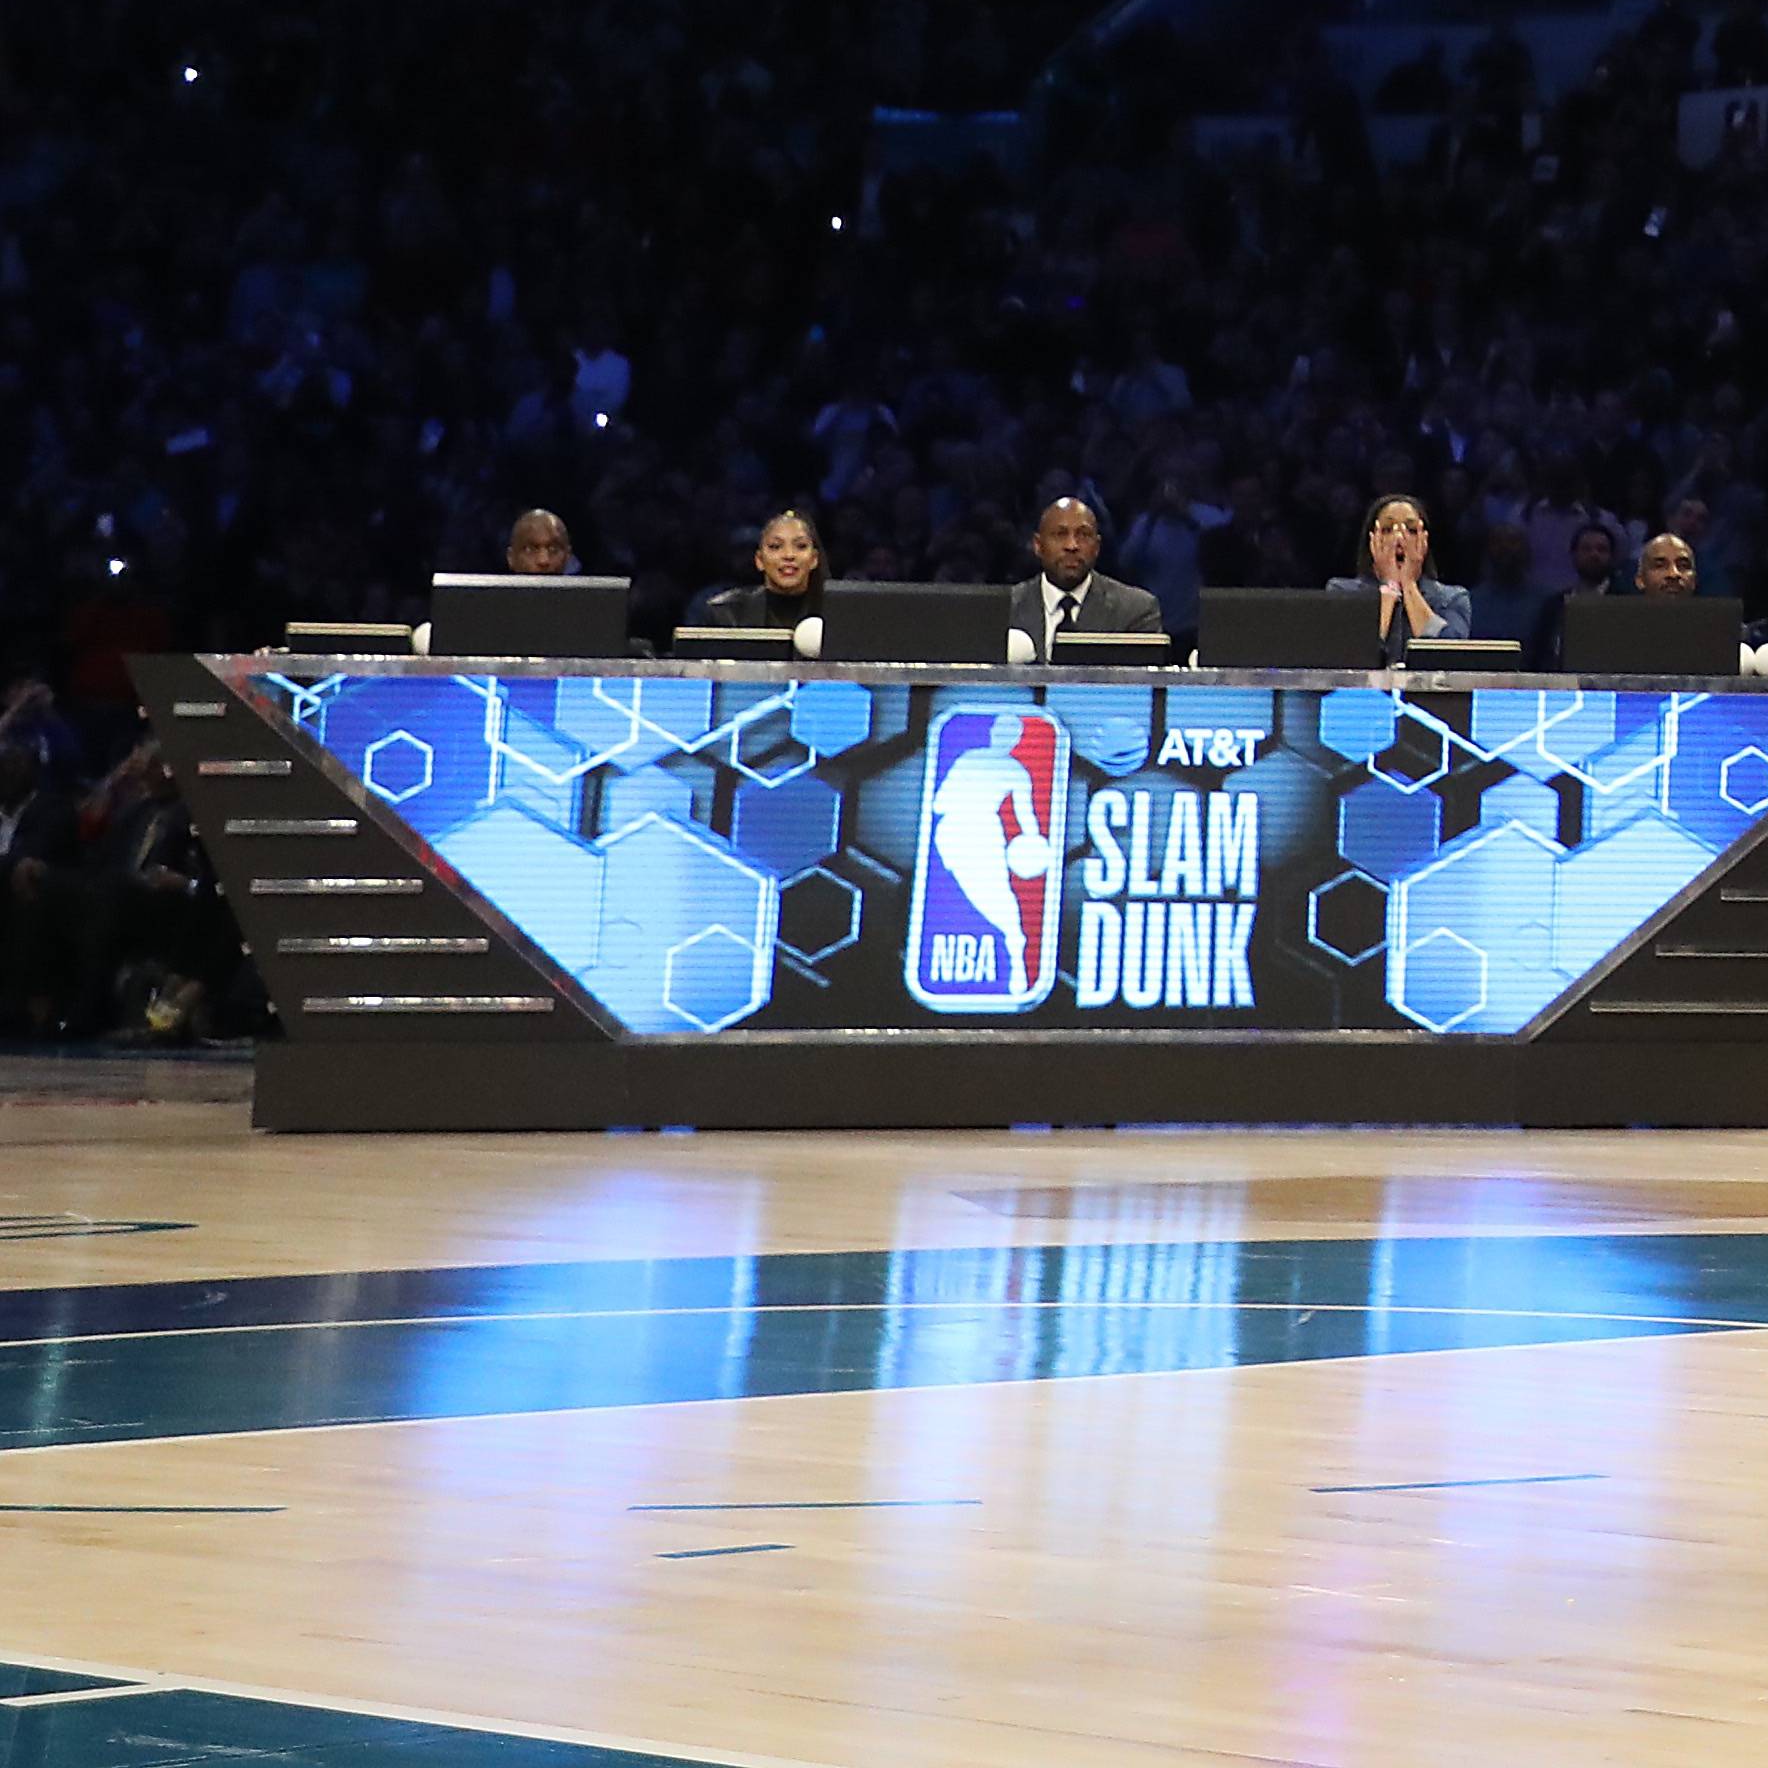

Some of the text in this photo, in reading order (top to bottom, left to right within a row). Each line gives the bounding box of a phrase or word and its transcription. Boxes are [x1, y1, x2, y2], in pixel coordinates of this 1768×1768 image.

[1158, 729, 1265, 767] AT&T
[1083, 789, 1259, 899] SLAM
[930, 934, 998, 984] NBA
[1076, 902, 1257, 1010] DUNK
